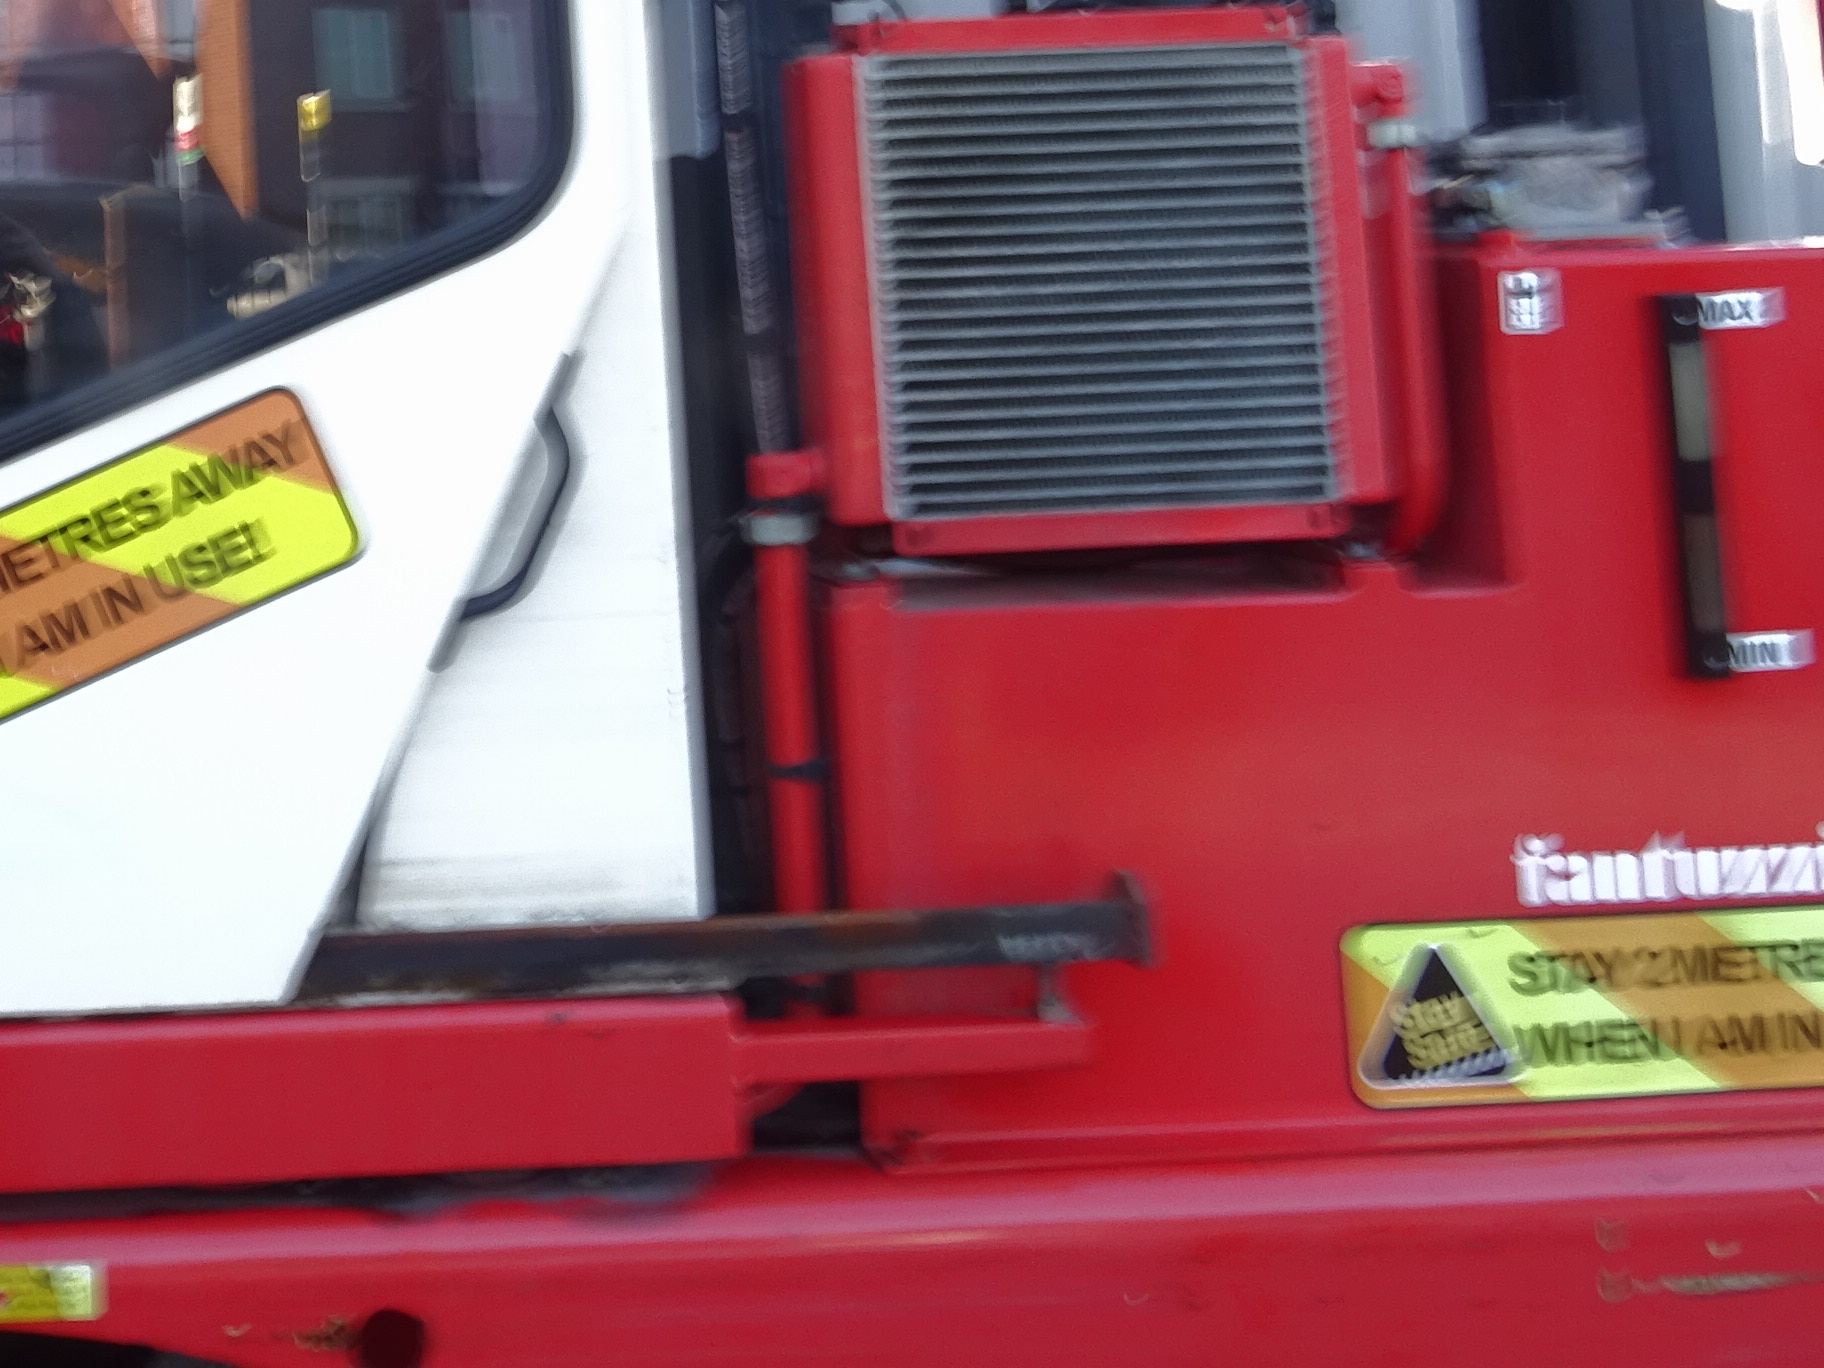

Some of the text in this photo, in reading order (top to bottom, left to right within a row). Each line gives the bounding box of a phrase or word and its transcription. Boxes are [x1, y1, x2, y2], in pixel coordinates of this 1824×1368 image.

[1697, 298, 1754, 323] MAX
[170, 421, 298, 519] AWAY
[14, 599, 94, 668] AM
[88, 571, 145, 629] IN
[142, 520, 272, 601] USE!
[1727, 640, 1782, 666] MIN
[1508, 950, 1620, 996] STAY
[1631, 947, 1670, 987] 2
[1512, 1018, 1661, 1067] WHEN
[1696, 1013, 1767, 1057] AM
[1776, 1010, 1823, 1051] IN
